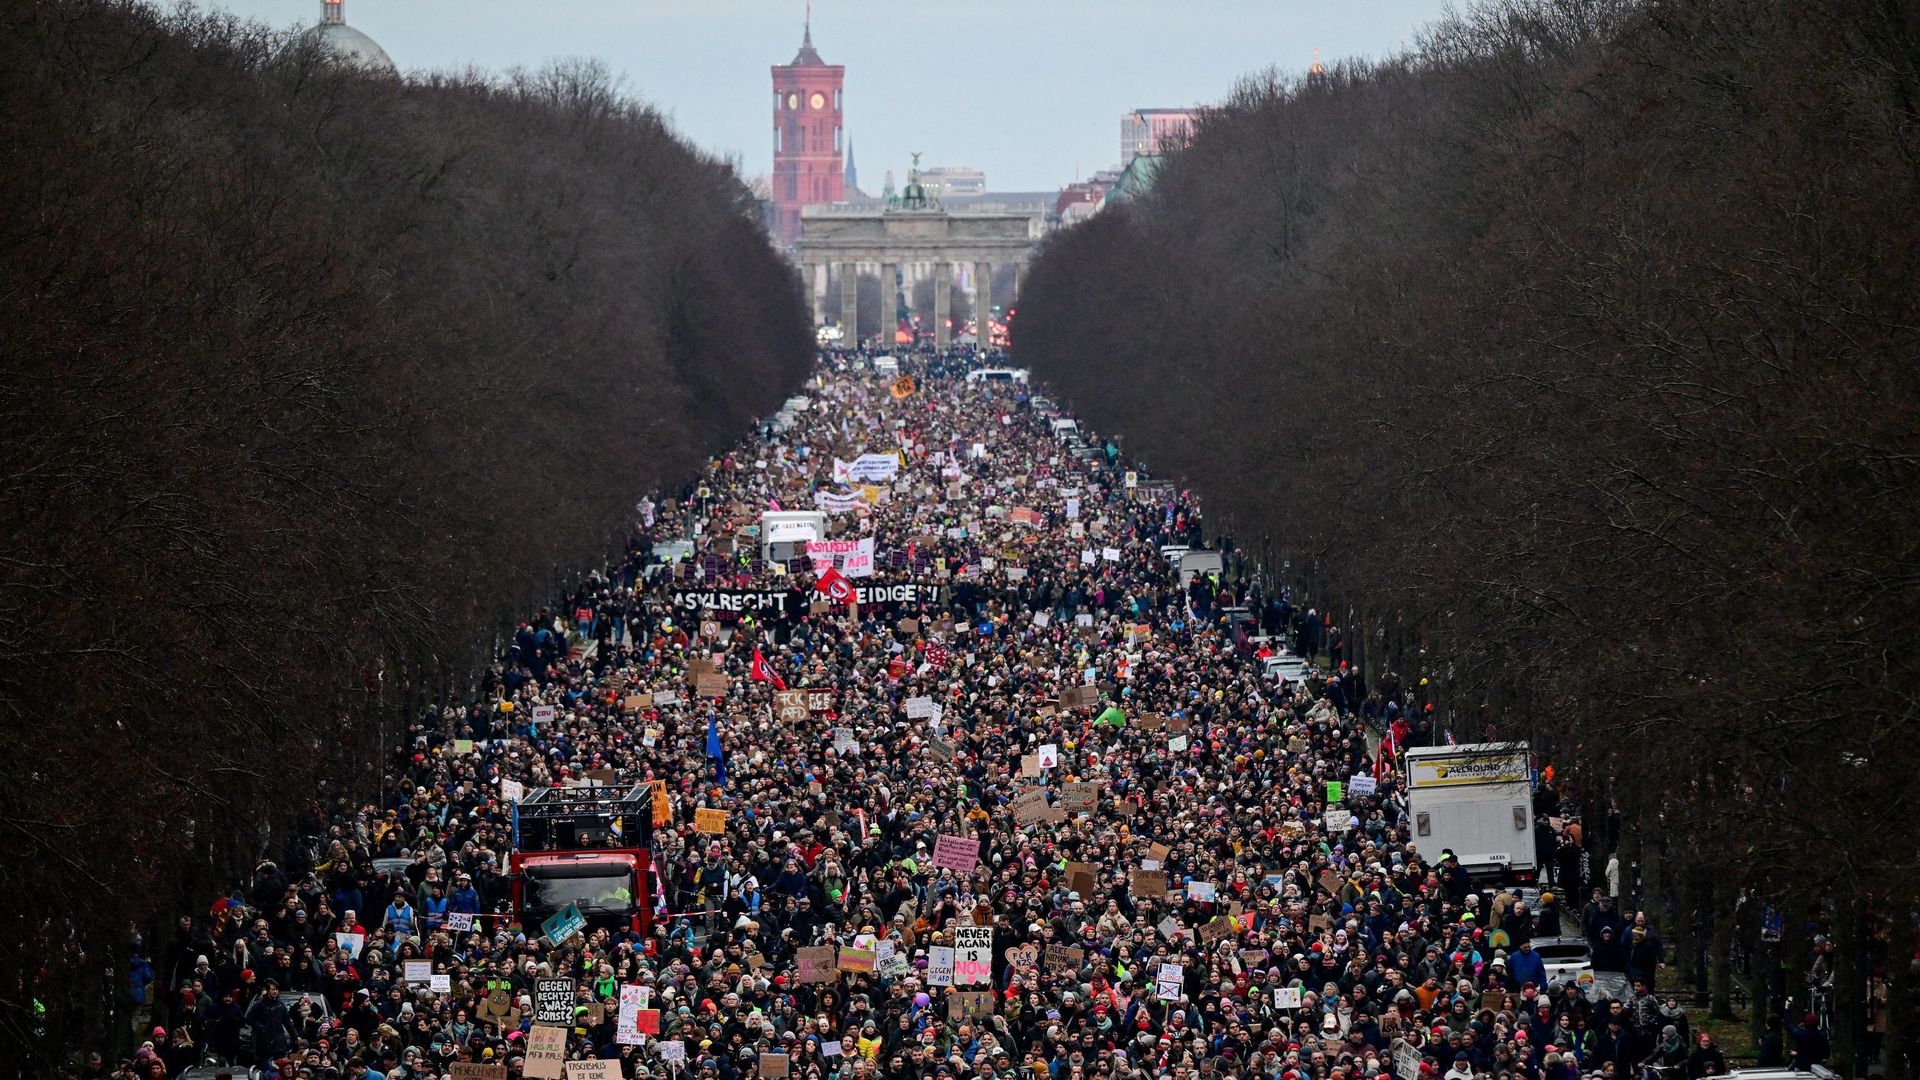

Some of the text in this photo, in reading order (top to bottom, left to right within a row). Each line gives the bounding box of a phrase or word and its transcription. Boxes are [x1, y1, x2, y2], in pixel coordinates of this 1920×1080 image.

[806, 541, 860, 553] ASYLRECHT
[674, 592, 788, 611] ASYLRECHT
[809, 692, 831, 702] FCK
[809, 701, 830, 711] NZS
[1450, 764, 1501, 773] ALLROUND
[450, 914, 472, 922] 2+2=4
[956, 928, 991, 939] NEVER
[957, 939, 991, 949] AGAIN
[967, 950, 978, 962] IS
[1013, 951, 1032, 961] FCK
[930, 967, 952, 975] GEGEN
[955, 960, 991, 977] NOW
[538, 980, 571, 992] GEGEN
[537, 991, 575, 1005] RECHTS!
[568, 1061, 607, 1070] FASCHISMUS
